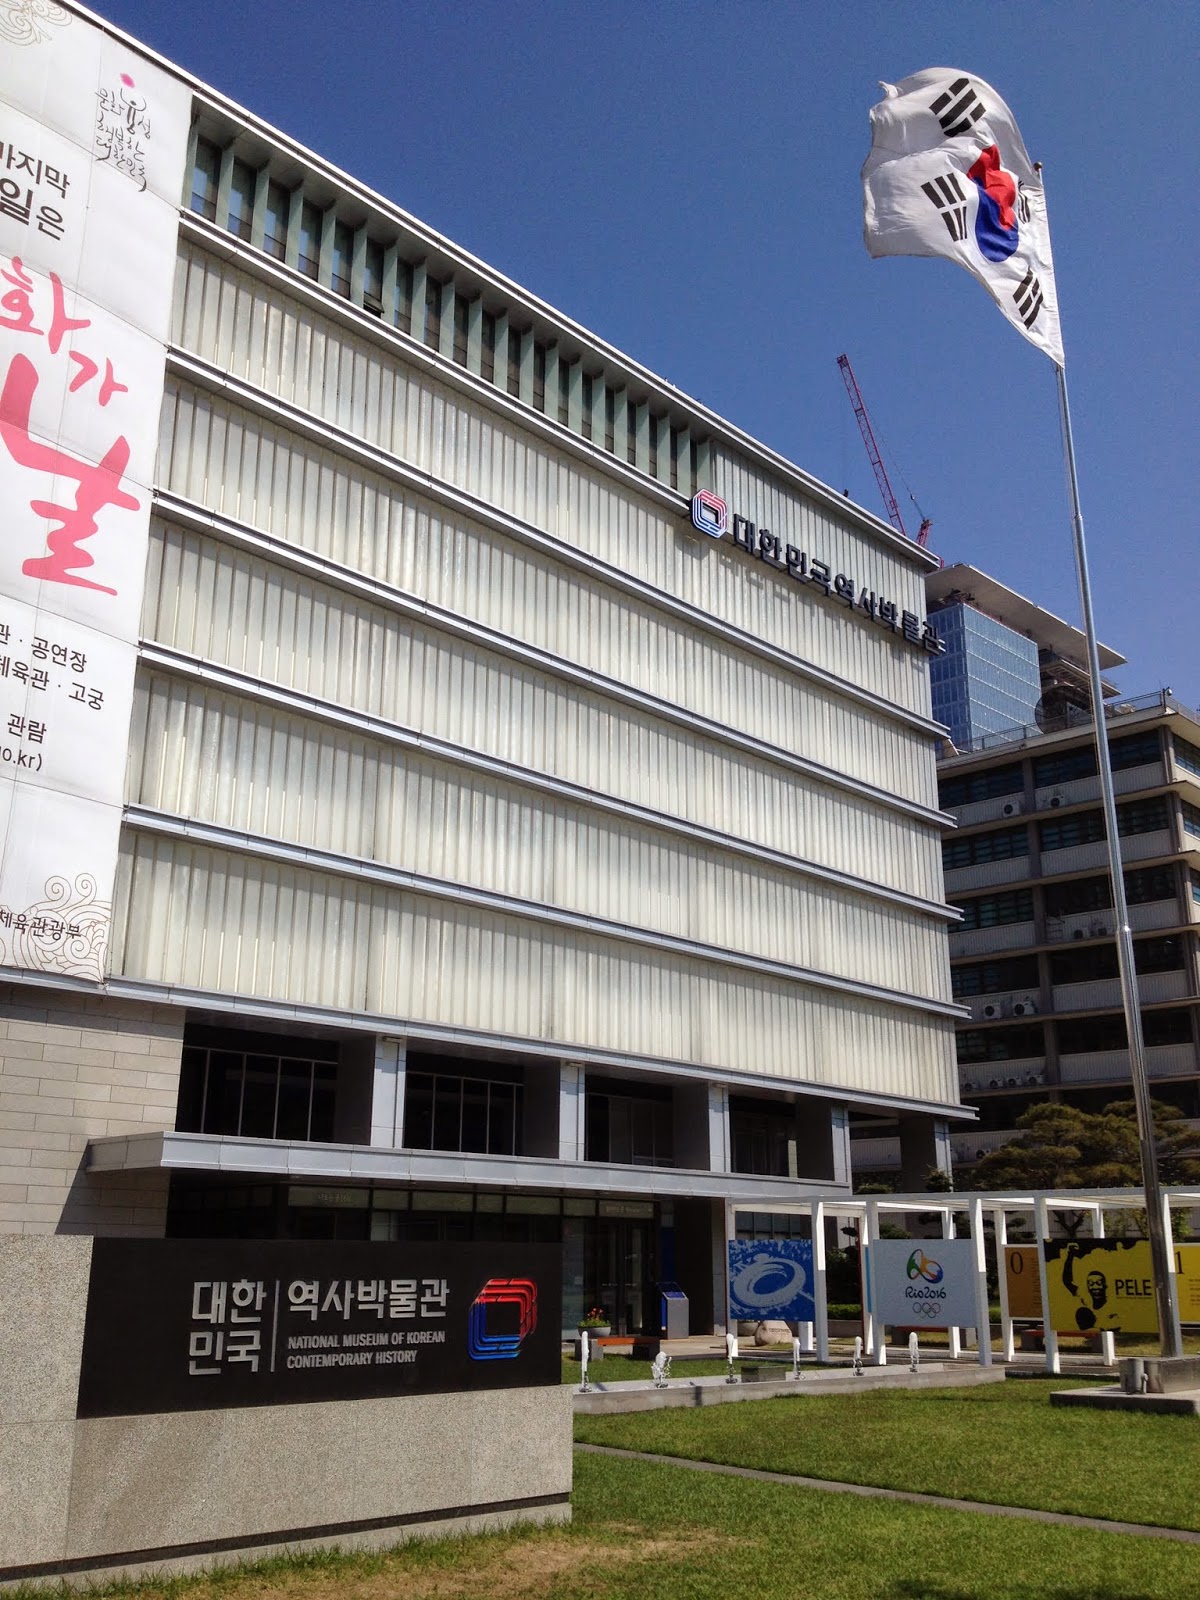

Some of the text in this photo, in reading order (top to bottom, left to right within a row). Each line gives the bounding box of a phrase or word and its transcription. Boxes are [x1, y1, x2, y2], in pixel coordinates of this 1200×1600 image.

[31, 636, 87, 673] 공연장
[69, 682, 104, 711] 고궁
[7, 713, 47, 744] 관람
[192, 1279, 267, 1324] 대한
[288, 1279, 450, 1321] 역사박물관
[1115, 1279, 1153, 1296] PELE
[189, 1330, 261, 1375] 민국
[288, 1330, 446, 1349] NATIONAL MUSEUM OF KOREAN
[287, 1350, 418, 1369] CONTEMPORARY HISTORY
